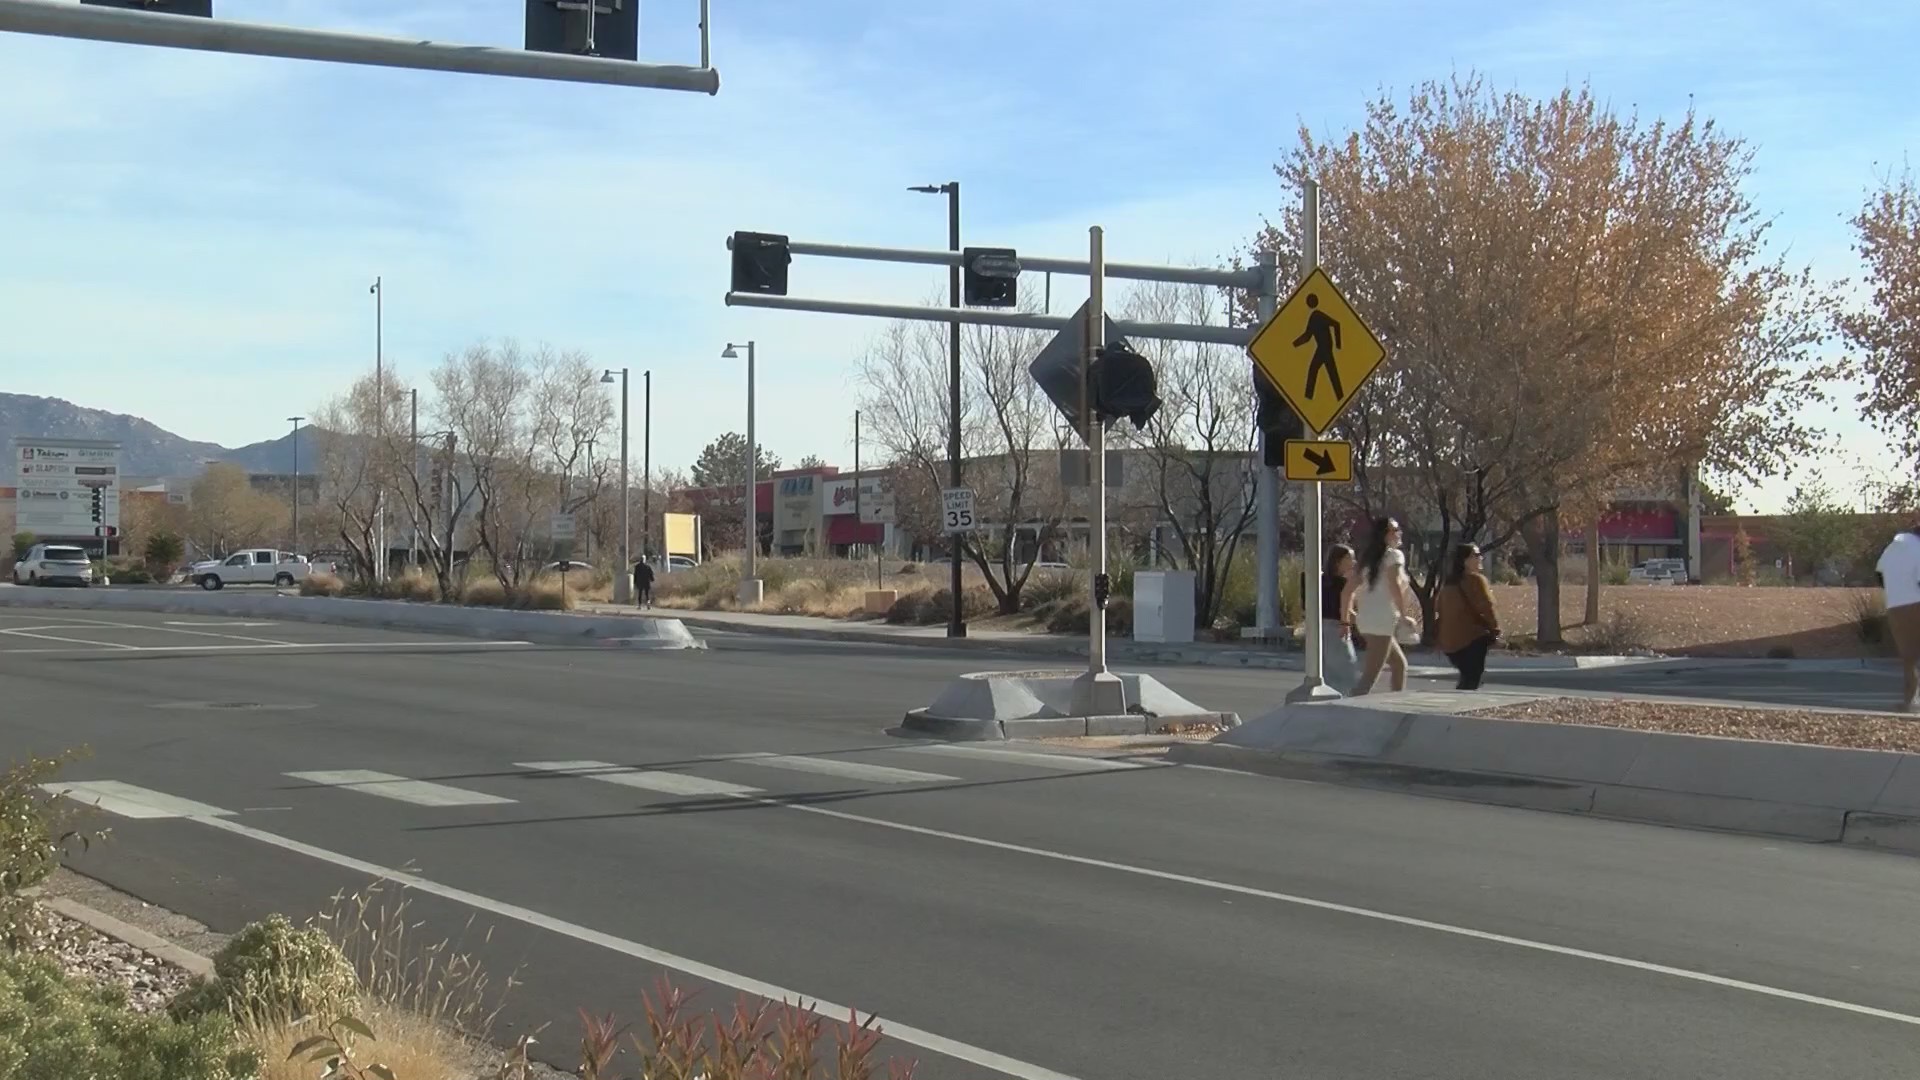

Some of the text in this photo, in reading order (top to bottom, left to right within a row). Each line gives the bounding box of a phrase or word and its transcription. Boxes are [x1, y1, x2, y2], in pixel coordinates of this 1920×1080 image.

[943, 491, 971, 500] SPEED
[947, 501, 968, 510] LIMIT
[947, 510, 972, 527] 35
